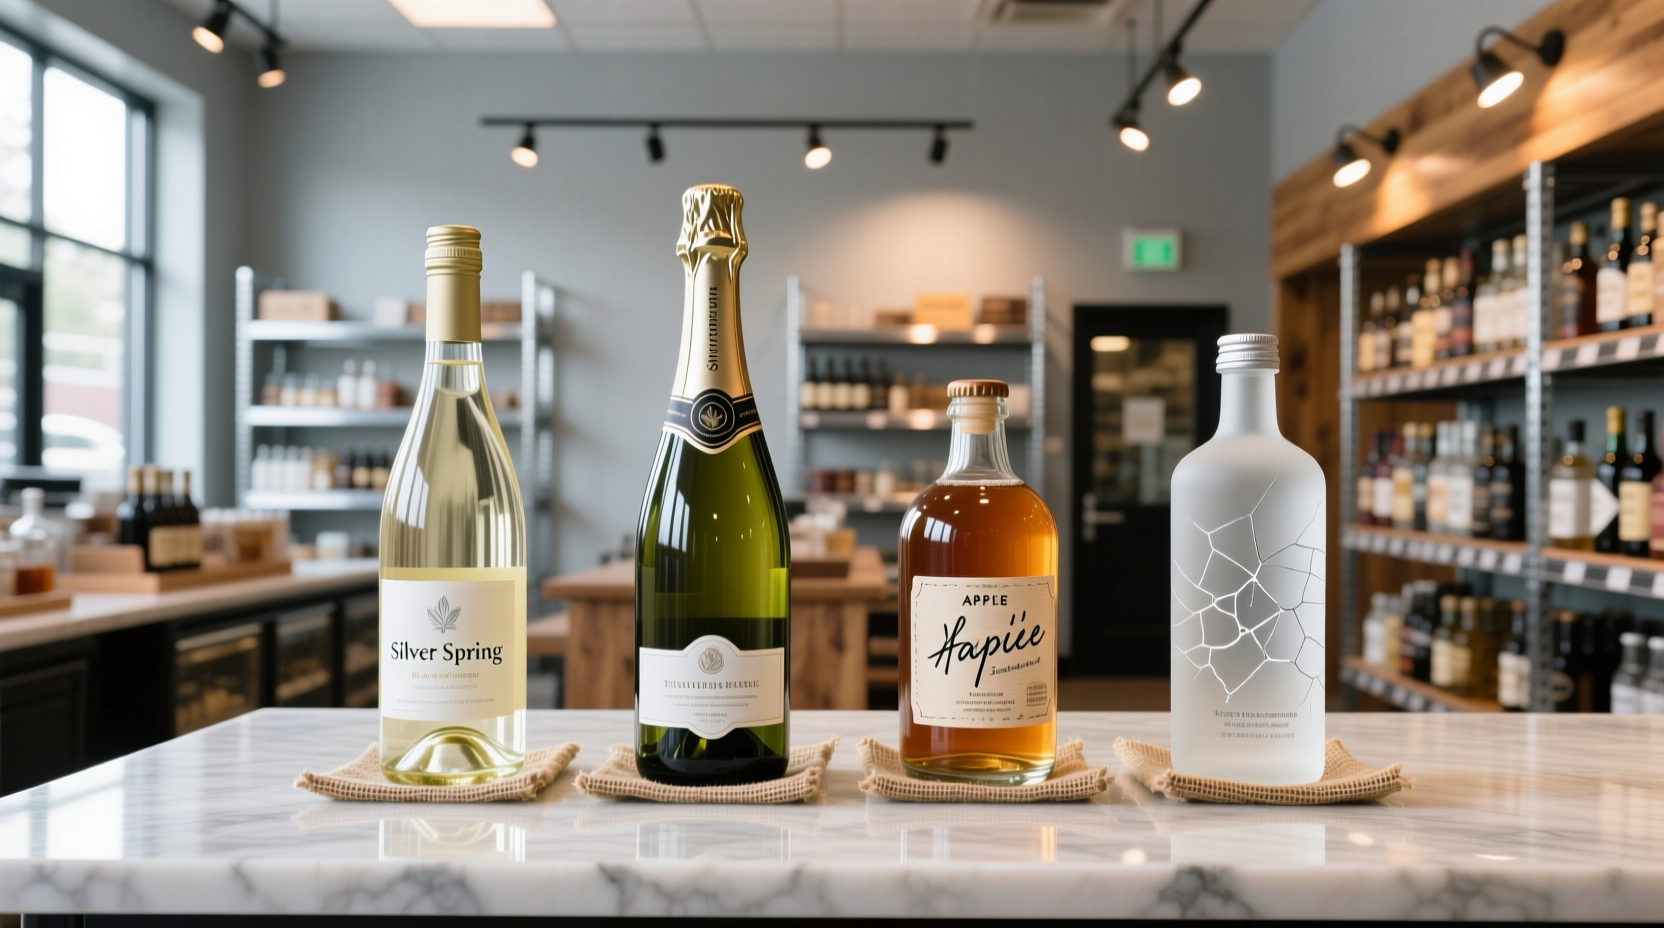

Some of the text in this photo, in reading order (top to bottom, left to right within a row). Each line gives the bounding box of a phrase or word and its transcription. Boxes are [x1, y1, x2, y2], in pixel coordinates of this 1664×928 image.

[962, 595, 1008, 606] APPLE
[391, 641, 503, 666] Silver Spring
